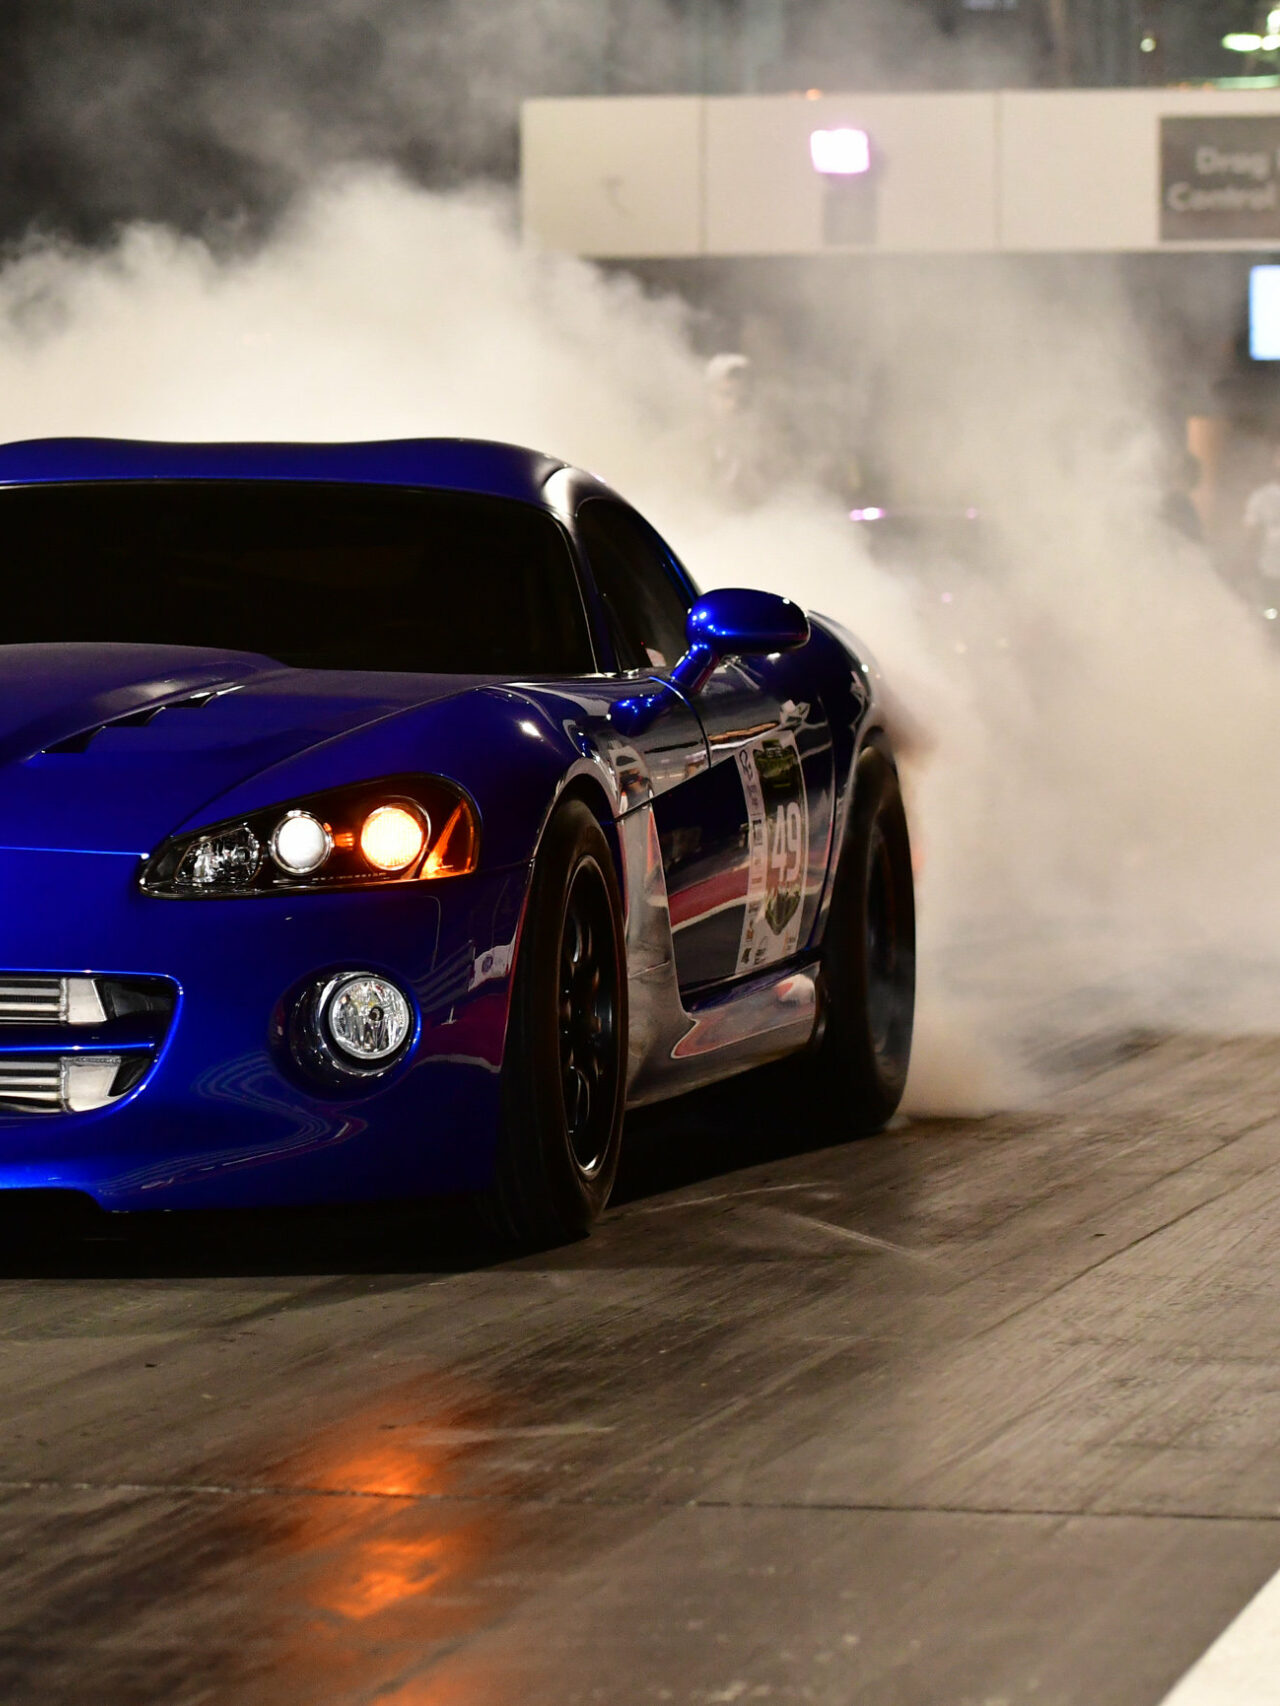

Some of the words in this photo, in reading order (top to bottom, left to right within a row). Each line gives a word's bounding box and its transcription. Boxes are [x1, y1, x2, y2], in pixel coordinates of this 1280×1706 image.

[1196, 146, 1270, 180] Drag
[1167, 182, 1276, 211] Control
[771, 801, 801, 882] 49
